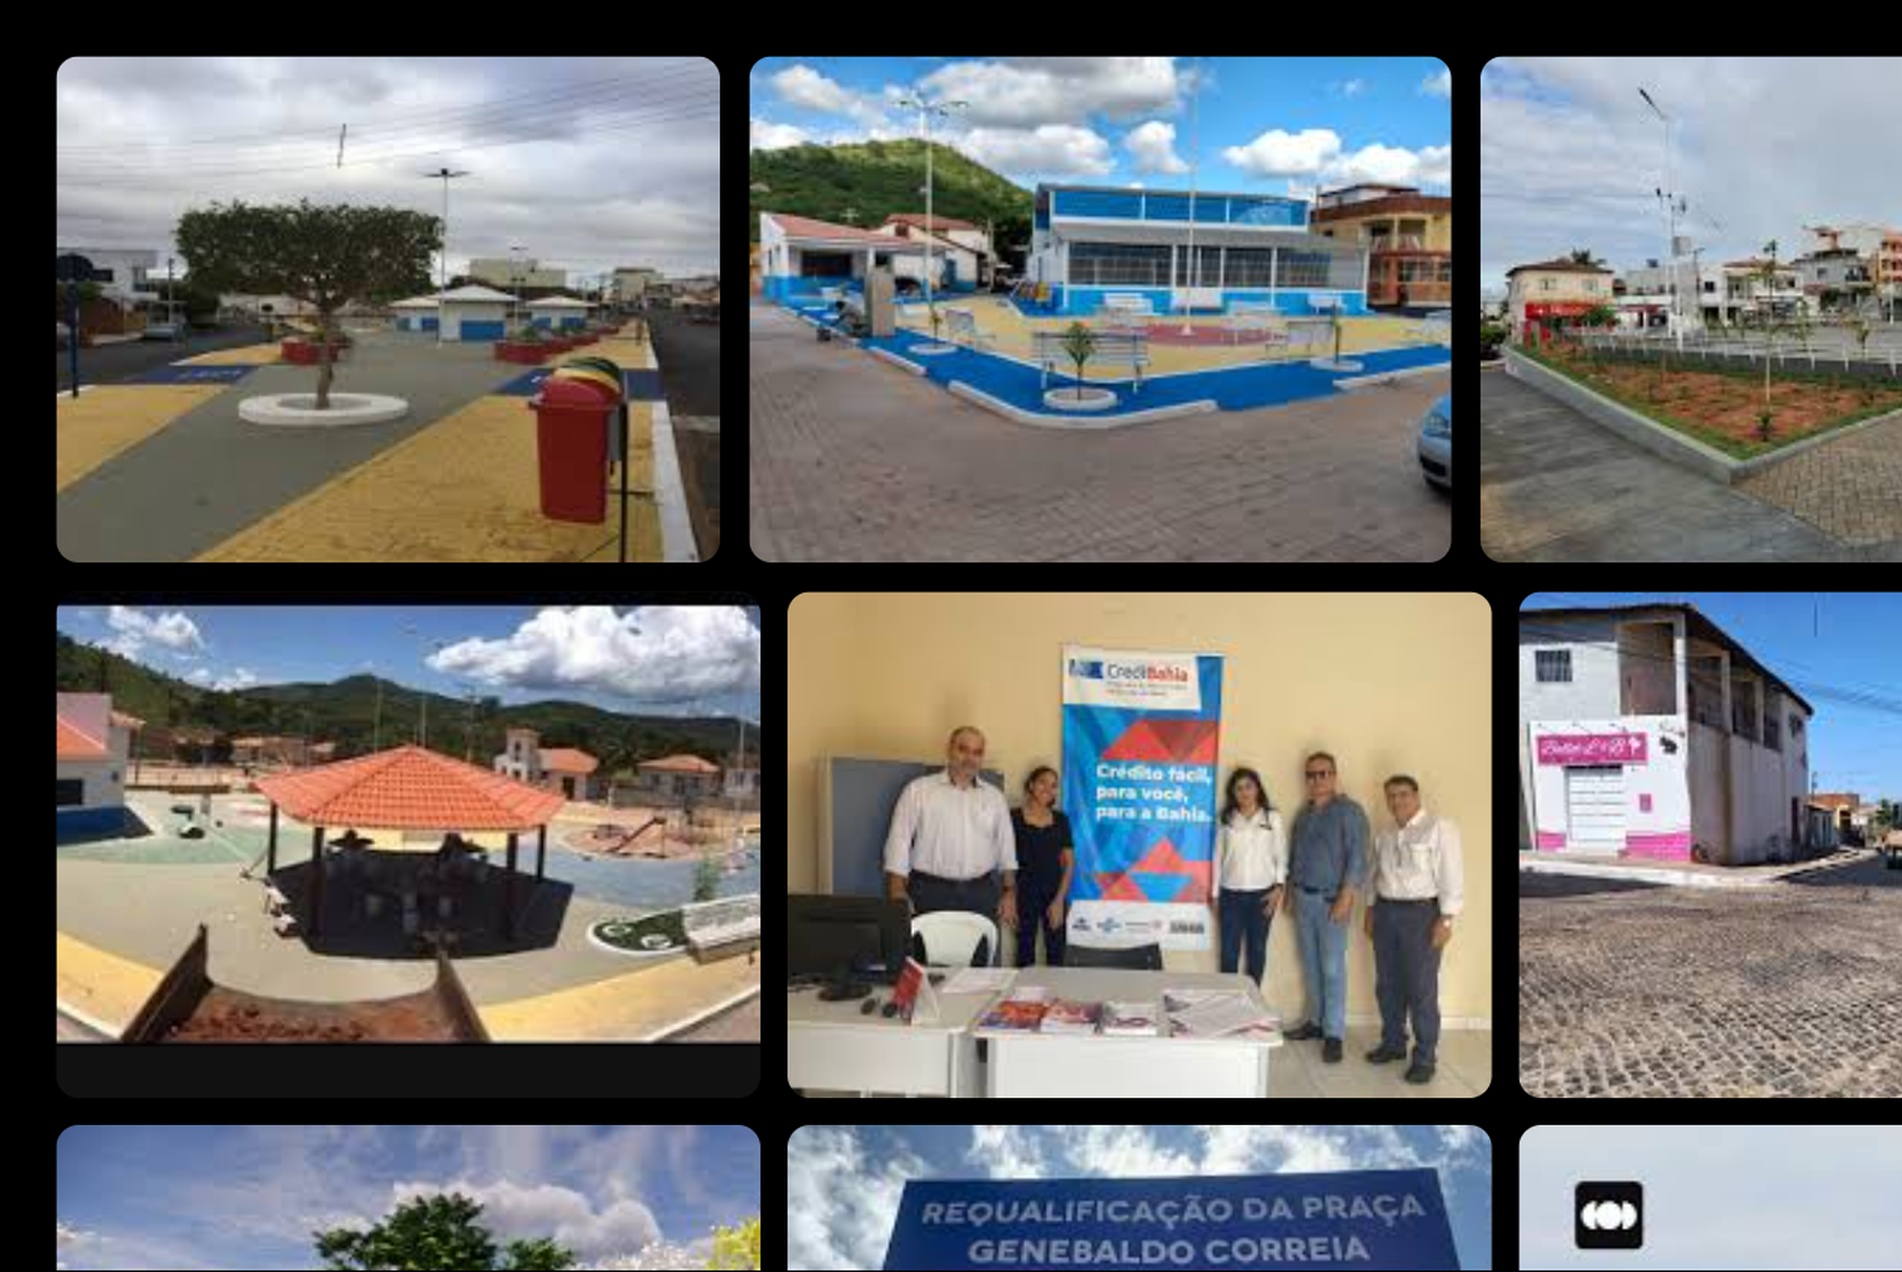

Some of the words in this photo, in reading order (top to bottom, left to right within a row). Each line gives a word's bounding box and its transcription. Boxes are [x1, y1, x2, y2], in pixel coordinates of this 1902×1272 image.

[1097, 787, 1137, 801] para
[1097, 807, 1137, 822] para
[922, 1195, 1234, 1230] REQUALIFICAÇÃO
[1243, 1197, 1295, 1220] DA
[1303, 1193, 1427, 1227] PRAÇA
[967, 1239, 1197, 1265] GENEBALDO
[1205, 1236, 1371, 1264] CORREIA
